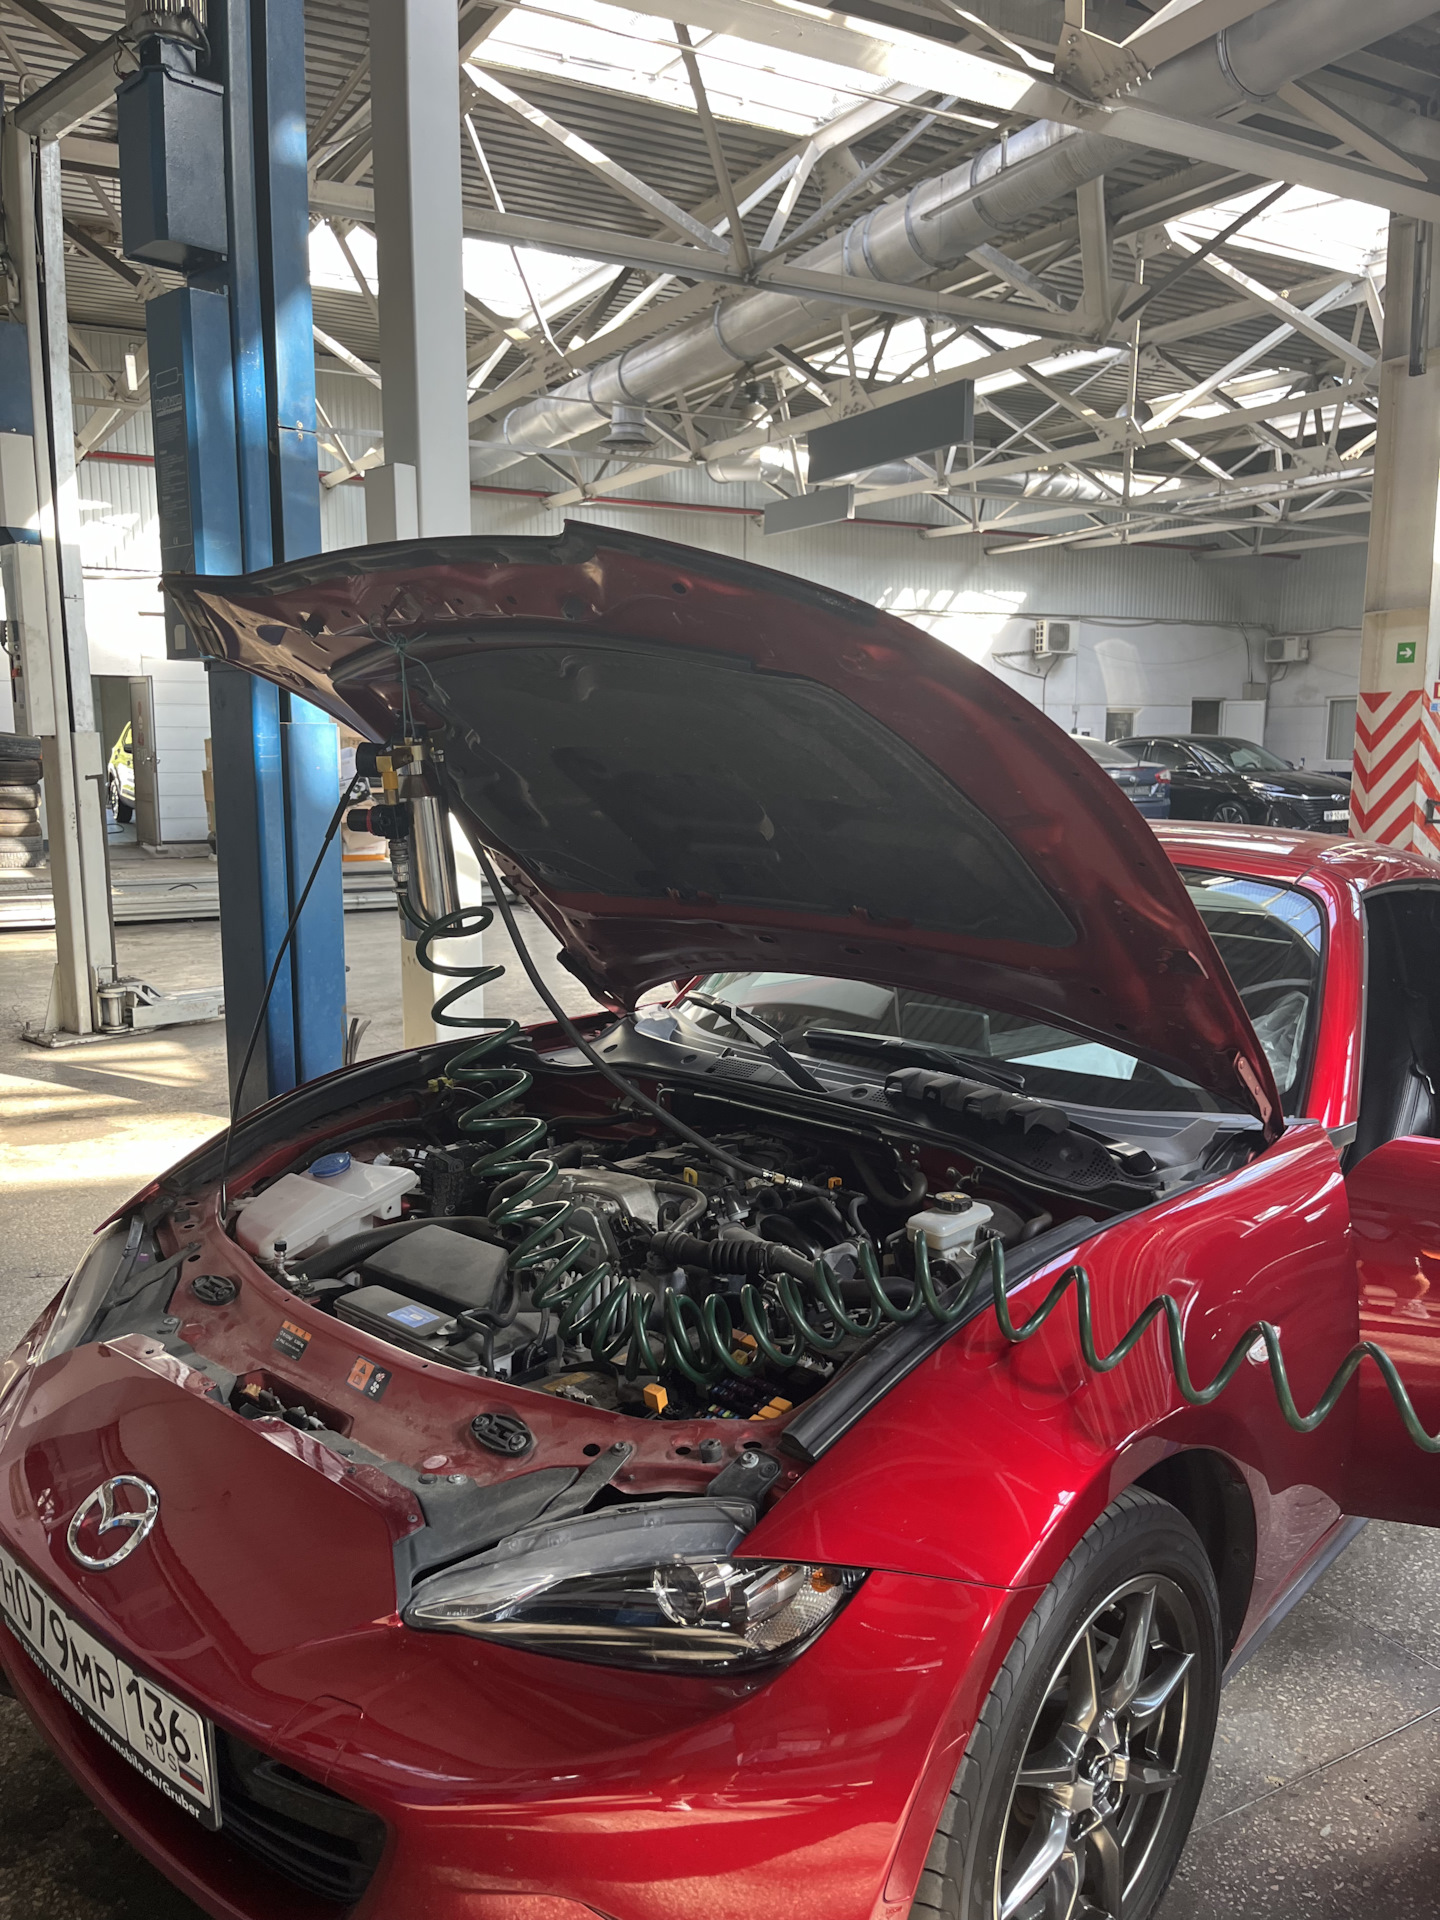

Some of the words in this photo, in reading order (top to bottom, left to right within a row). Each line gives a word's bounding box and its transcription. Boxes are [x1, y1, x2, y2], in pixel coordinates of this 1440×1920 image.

[126, 1679, 191, 1763] 136
[145, 1736, 178, 1773] RUS
[88, 1715, 200, 1819] www.mobile.de/Gruber
